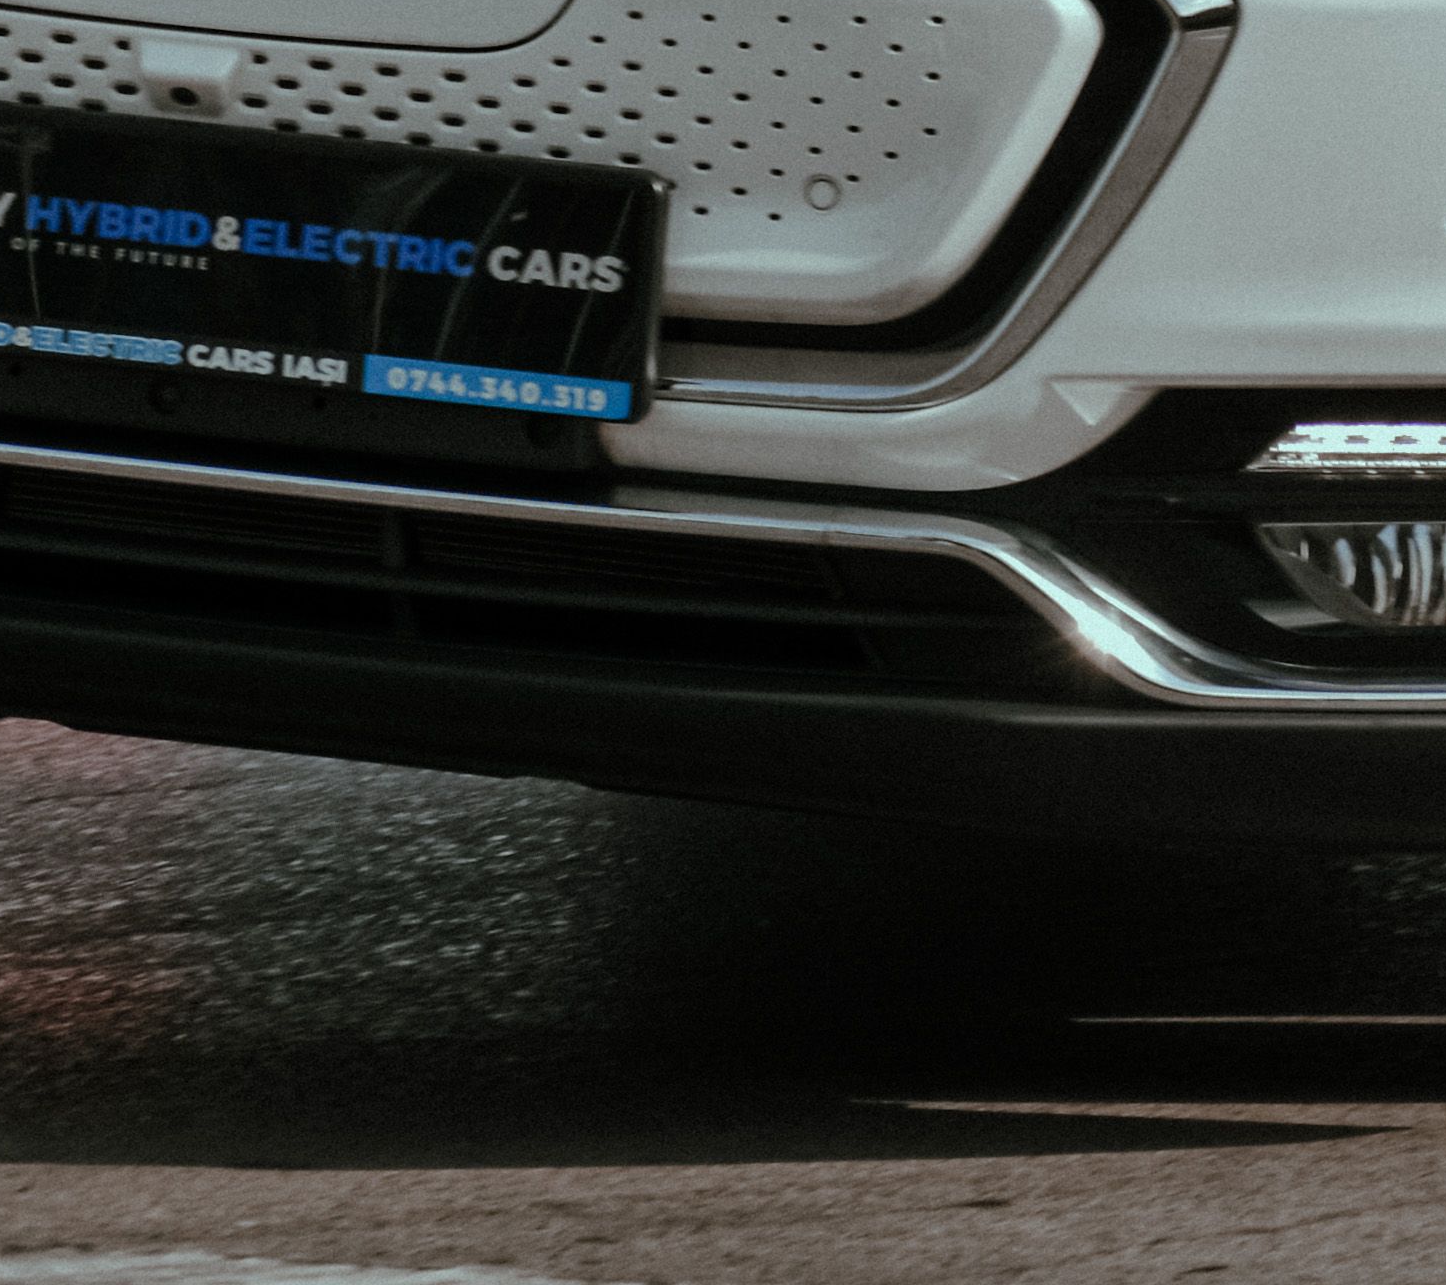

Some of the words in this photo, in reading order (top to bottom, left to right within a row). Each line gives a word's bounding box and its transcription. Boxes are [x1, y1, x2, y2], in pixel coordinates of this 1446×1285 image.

[56, 241, 101, 260] THE
[114, 247, 209, 271] FUTURE
[487, 245, 625, 293] CARS
[186, 343, 275, 376] CARS
